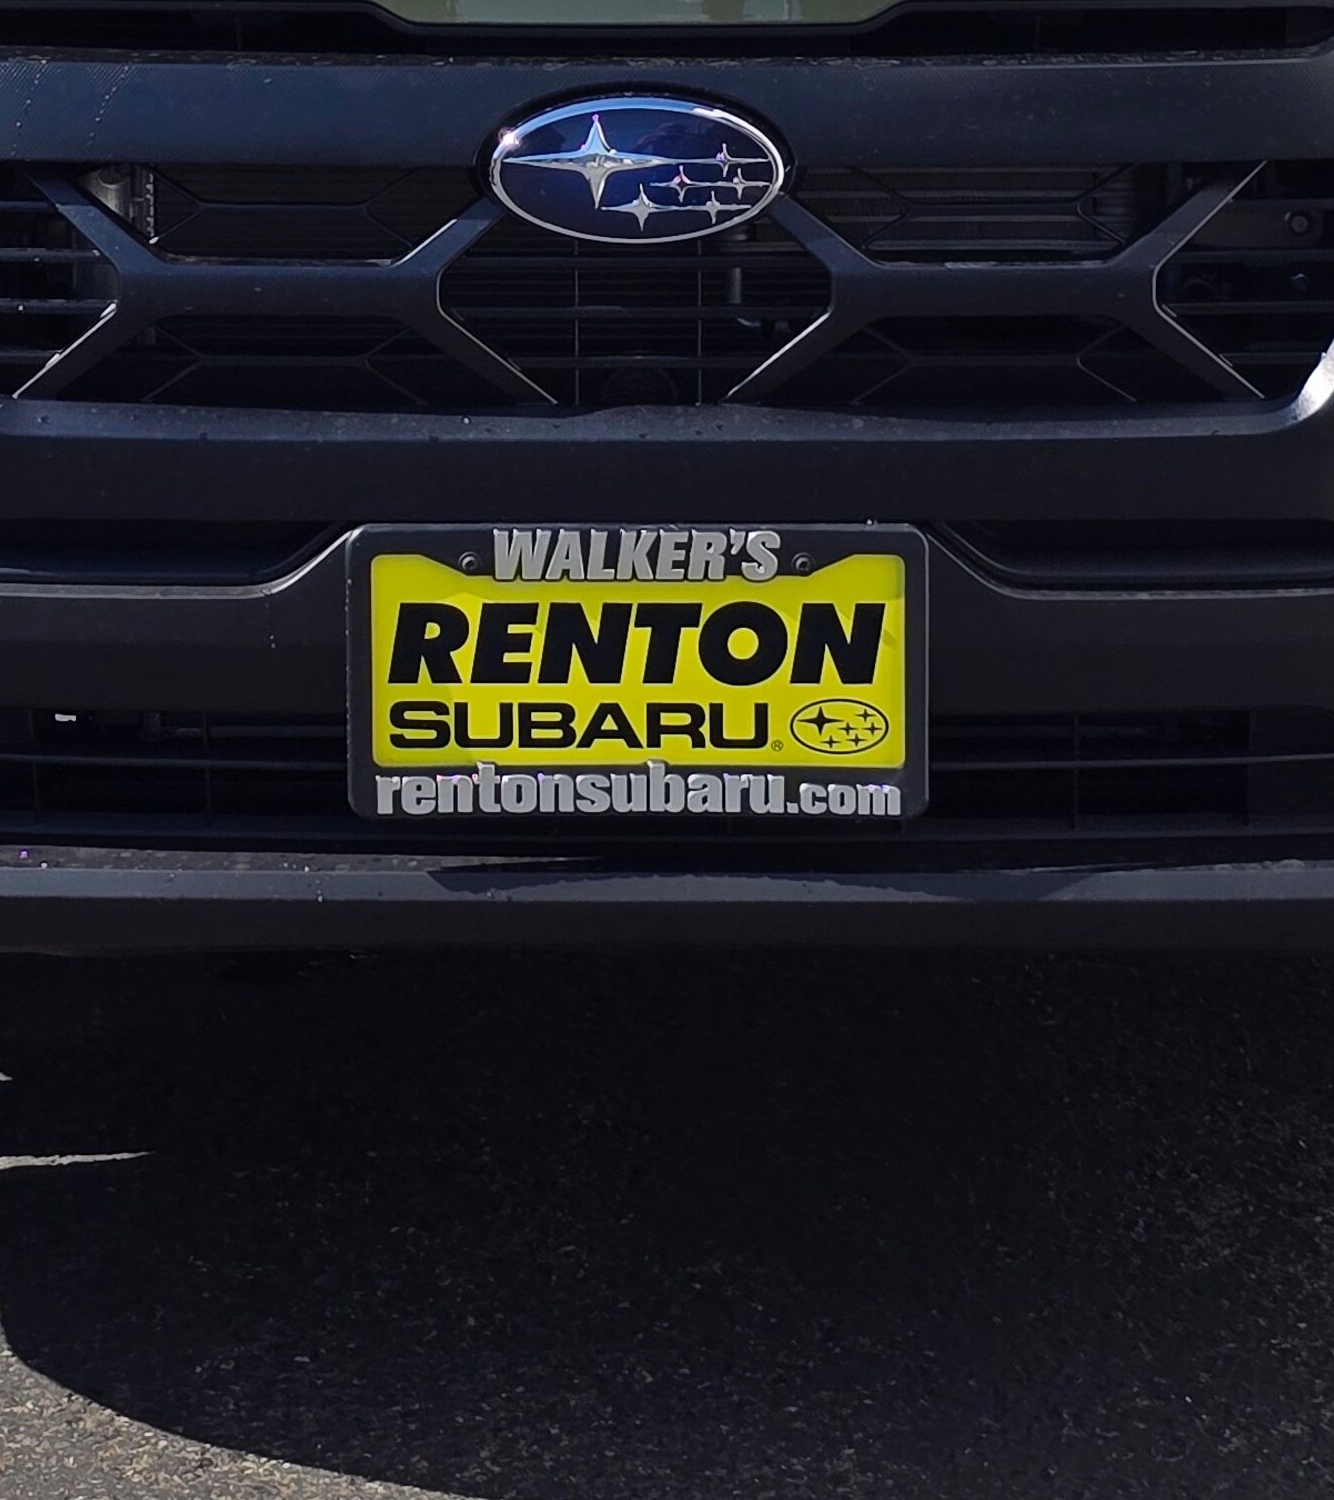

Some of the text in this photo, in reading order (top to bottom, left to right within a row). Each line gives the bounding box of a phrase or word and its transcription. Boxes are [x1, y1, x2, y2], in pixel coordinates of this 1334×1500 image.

[492, 528, 782, 582] WALKER'S
[388, 600, 886, 686] RENTON
[389, 700, 770, 749] SUBARU
[376, 762, 903, 815] rentonsubaru.com
